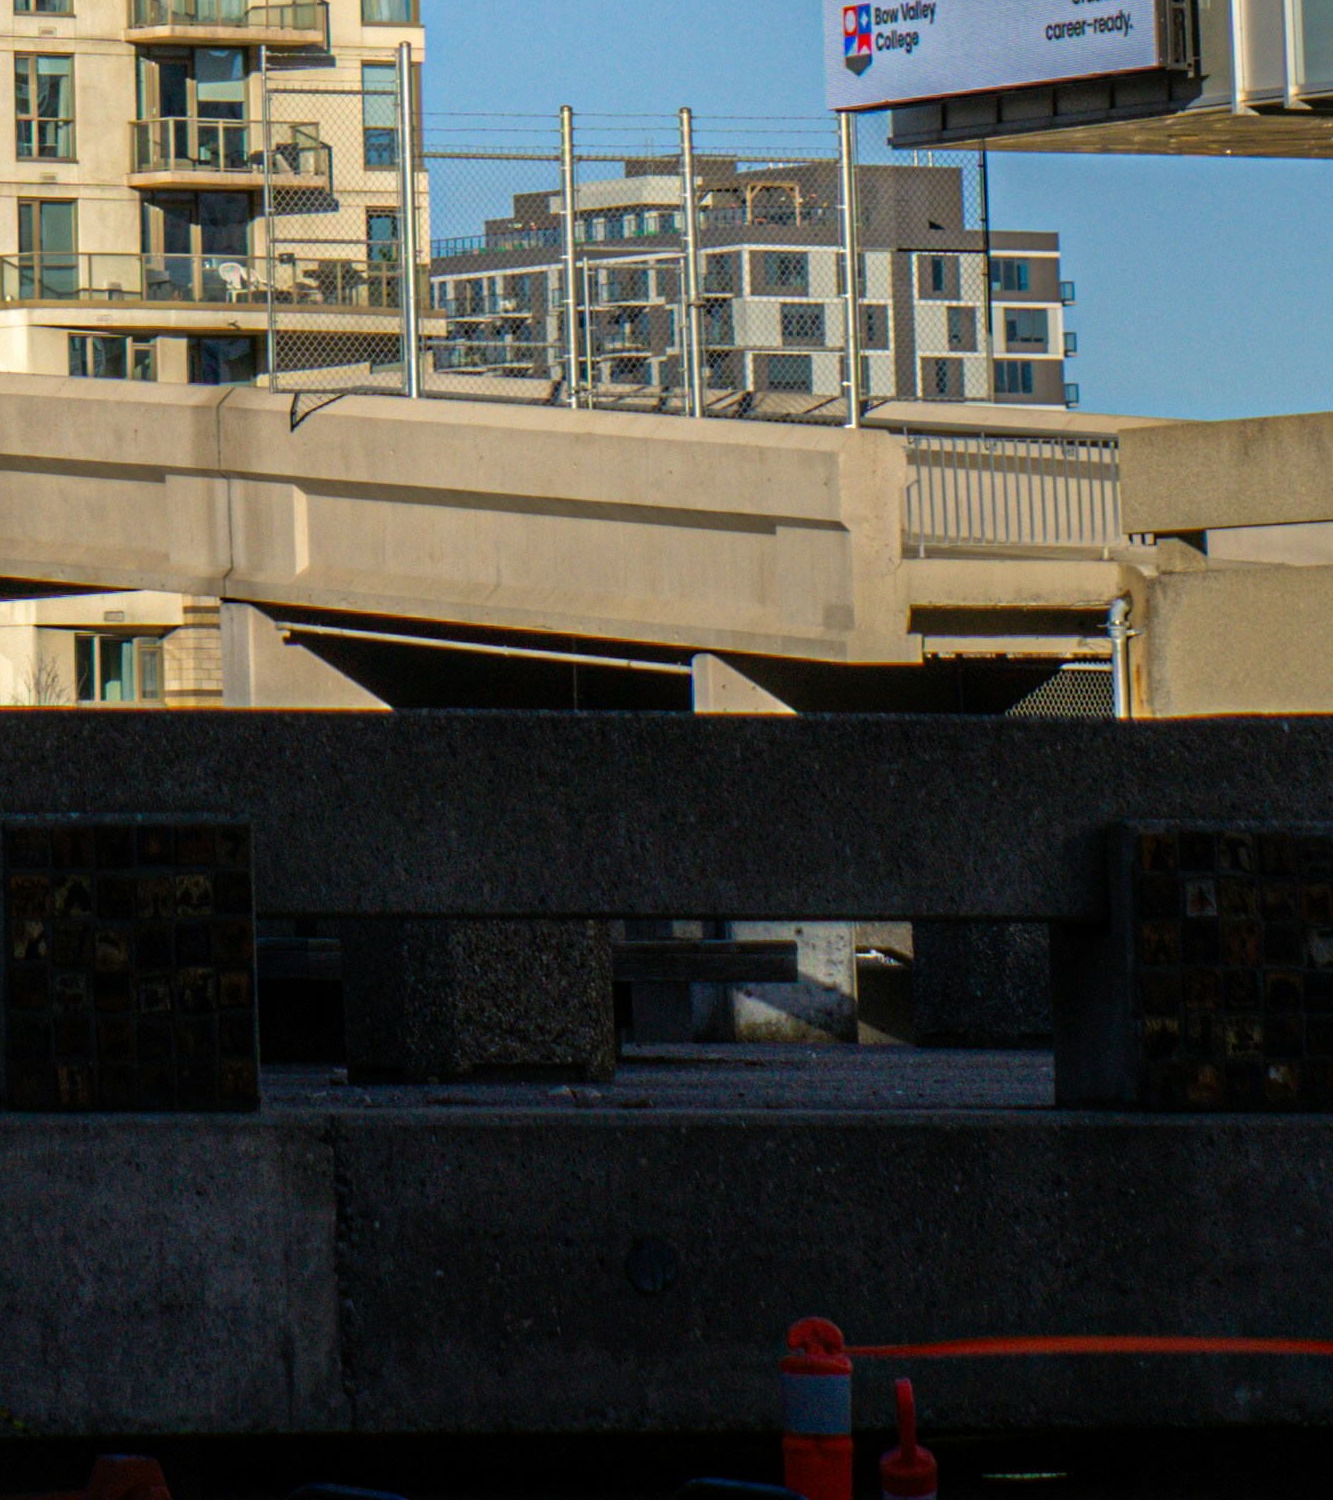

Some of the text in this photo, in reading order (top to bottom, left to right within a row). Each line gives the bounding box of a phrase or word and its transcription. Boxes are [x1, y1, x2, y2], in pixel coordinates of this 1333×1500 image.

[874, 0, 936, 26] Bow Valley
[1045, 10, 1133, 41] career-ready.
[875, 29, 920, 54] College
